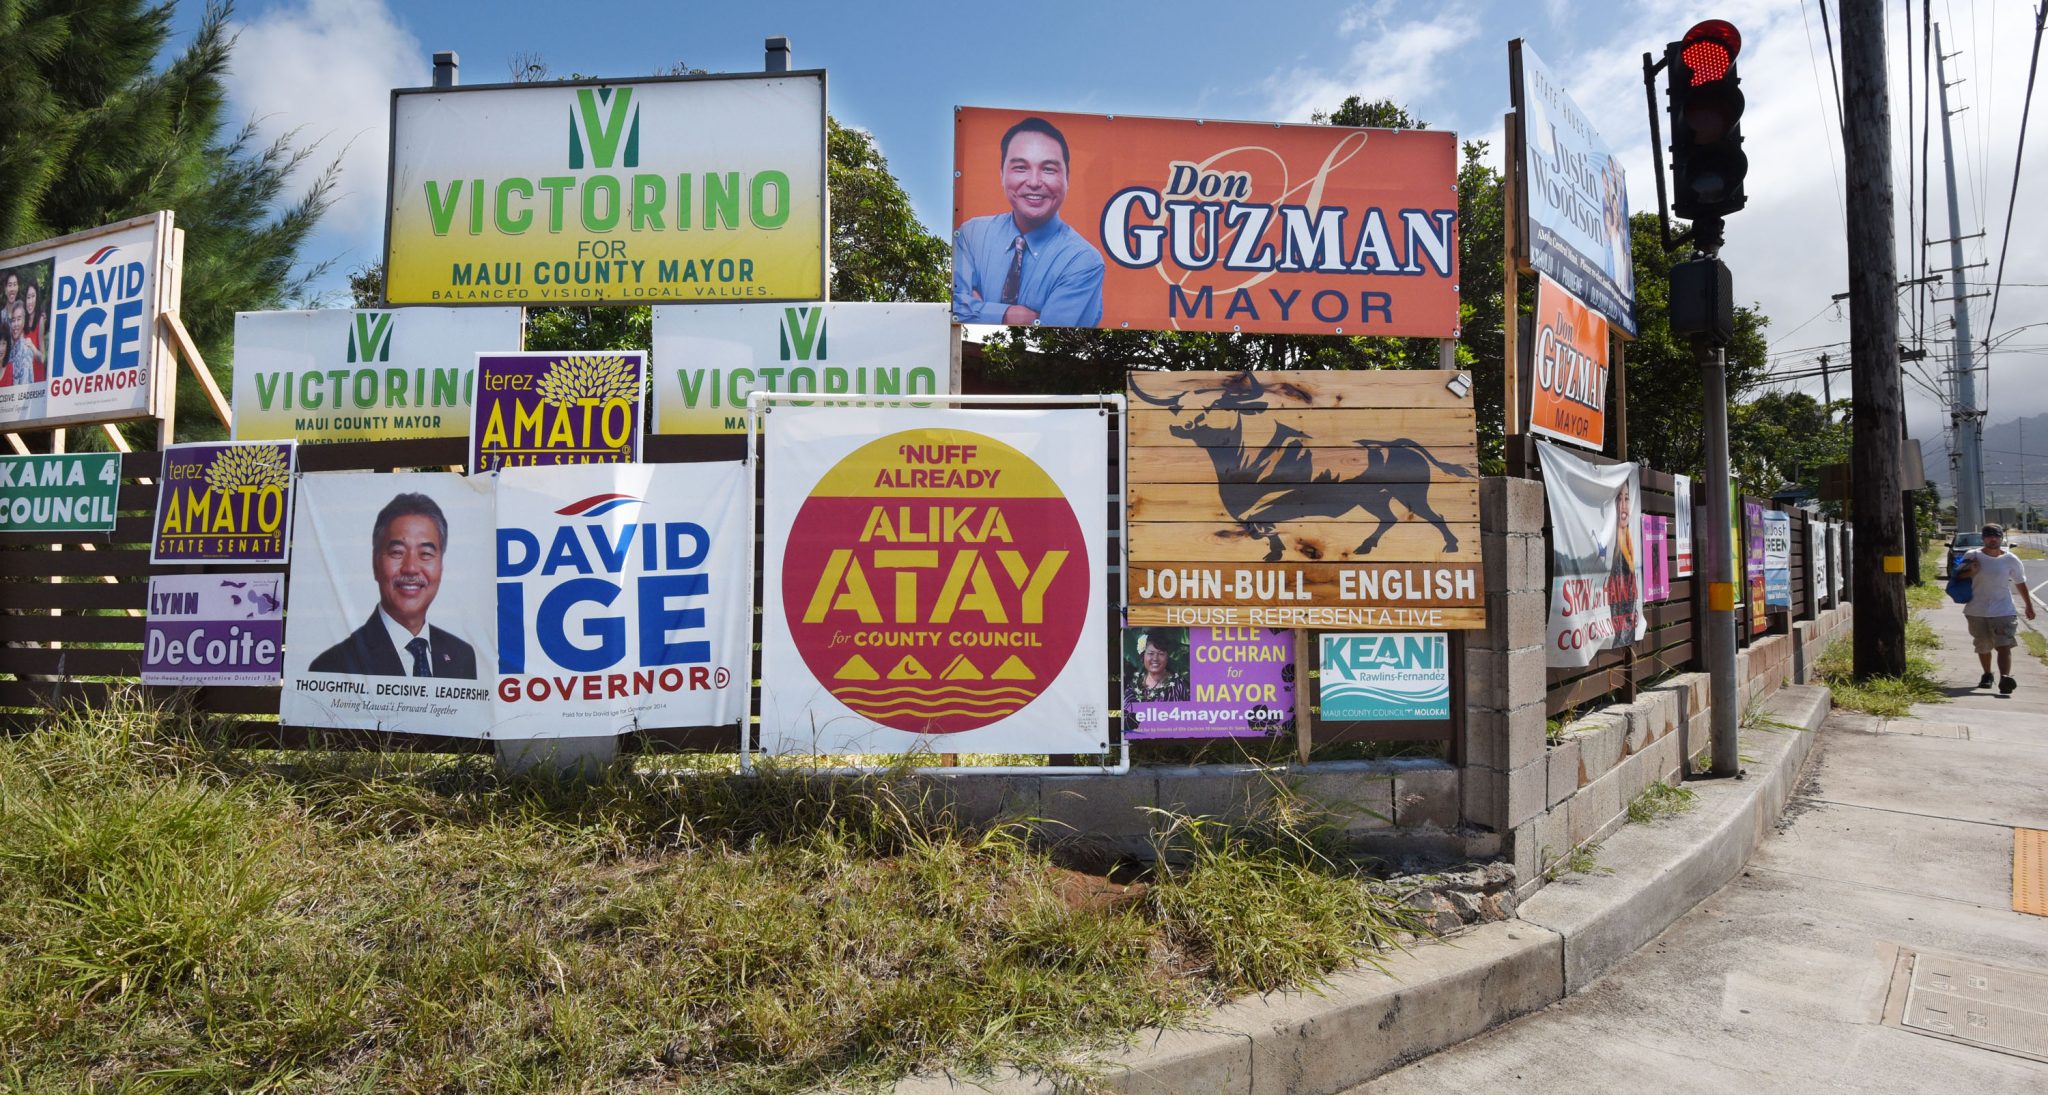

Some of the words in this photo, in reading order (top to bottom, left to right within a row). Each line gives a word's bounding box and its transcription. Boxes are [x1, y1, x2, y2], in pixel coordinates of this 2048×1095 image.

[1550, 122, 1600, 203] Justin
[1167, 164, 1249, 199] Don
[424, 170, 790, 236] VICTORINO
[1530, 146, 1604, 247] Woodson
[1100, 187, 1457, 277] GUZMAN
[578, 240, 626, 260] FOR
[452, 262, 521, 286] MAUI
[534, 260, 645, 285] COUNTY
[658, 258, 754, 283] MAYOR
[57, 261, 145, 310] DAVID
[432, 289, 529, 299] BALANCED
[623, 287, 683, 297] LOCAL
[694, 286, 774, 296] VALUES.
[1169, 284, 1393, 324] MAYOR
[52, 299, 143, 377] IGE
[1556, 311, 1573, 342] Don
[485, 369, 533, 391] terez
[1537, 324, 1607, 414] GUZMAN
[51, 371, 137, 397] GOVERNOR
[295, 418, 329, 430] MAUI
[334, 417, 388, 430] COUNTY
[394, 416, 441, 428] MAYOR
[481, 397, 632, 449] AMATO
[725, 417, 762, 430] MAI
[1556, 407, 1589, 437] MAYOR
[99, 459, 116, 485] 4
[169, 460, 203, 480] terez
[874, 468, 1001, 489] ALREADY
[0, 496, 113, 523] COUNCIL
[162, 485, 283, 533] AMATO
[859, 506, 1014, 543] ALIKA
[160, 540, 204, 553] STATE
[217, 539, 280, 553] SENATE
[496, 521, 711, 578] DAVID
[802, 549, 1070, 623] ATAY
[1139, 569, 1312, 600] JOHN-BULL
[1340, 569, 1476, 600] ENGLISH
[152, 592, 199, 615] LYNN
[1167, 607, 1238, 625] HOUSE
[1250, 607, 1442, 626] REPRESENTATIVE
[497, 573, 711, 675] IGE
[1212, 626, 1261, 641] ELLE
[147, 626, 276, 665] DeCoite
[828, 631, 852, 648] for
[854, 631, 941, 647] COUNTY
[949, 631, 1042, 647] COUNCIL
[1196, 645, 1286, 663] COCHRAN
[498, 667, 711, 703] GOVERNOR
[1227, 666, 1243, 678] for
[1360, 672, 1445, 681] Rawlins-Fernandez
[296, 680, 369, 694] THOUGHTFUL.
[376, 684, 428, 698] DECISIVE.
[436, 687, 490, 701] LEADERSHIP.
[1196, 683, 1277, 702] MAYOR
[331, 698, 361, 711] Moving
[396, 702, 427, 713] Forward
[429, 704, 457, 717] Together
[1135, 707, 1284, 724] elle4mayor.com
[1322, 709, 1340, 717] MAUI
[1342, 709, 1371, 717] COUNTY
[1372, 709, 1404, 717] COUNCIL
[1415, 708, 1446, 716] MOLOKAI
